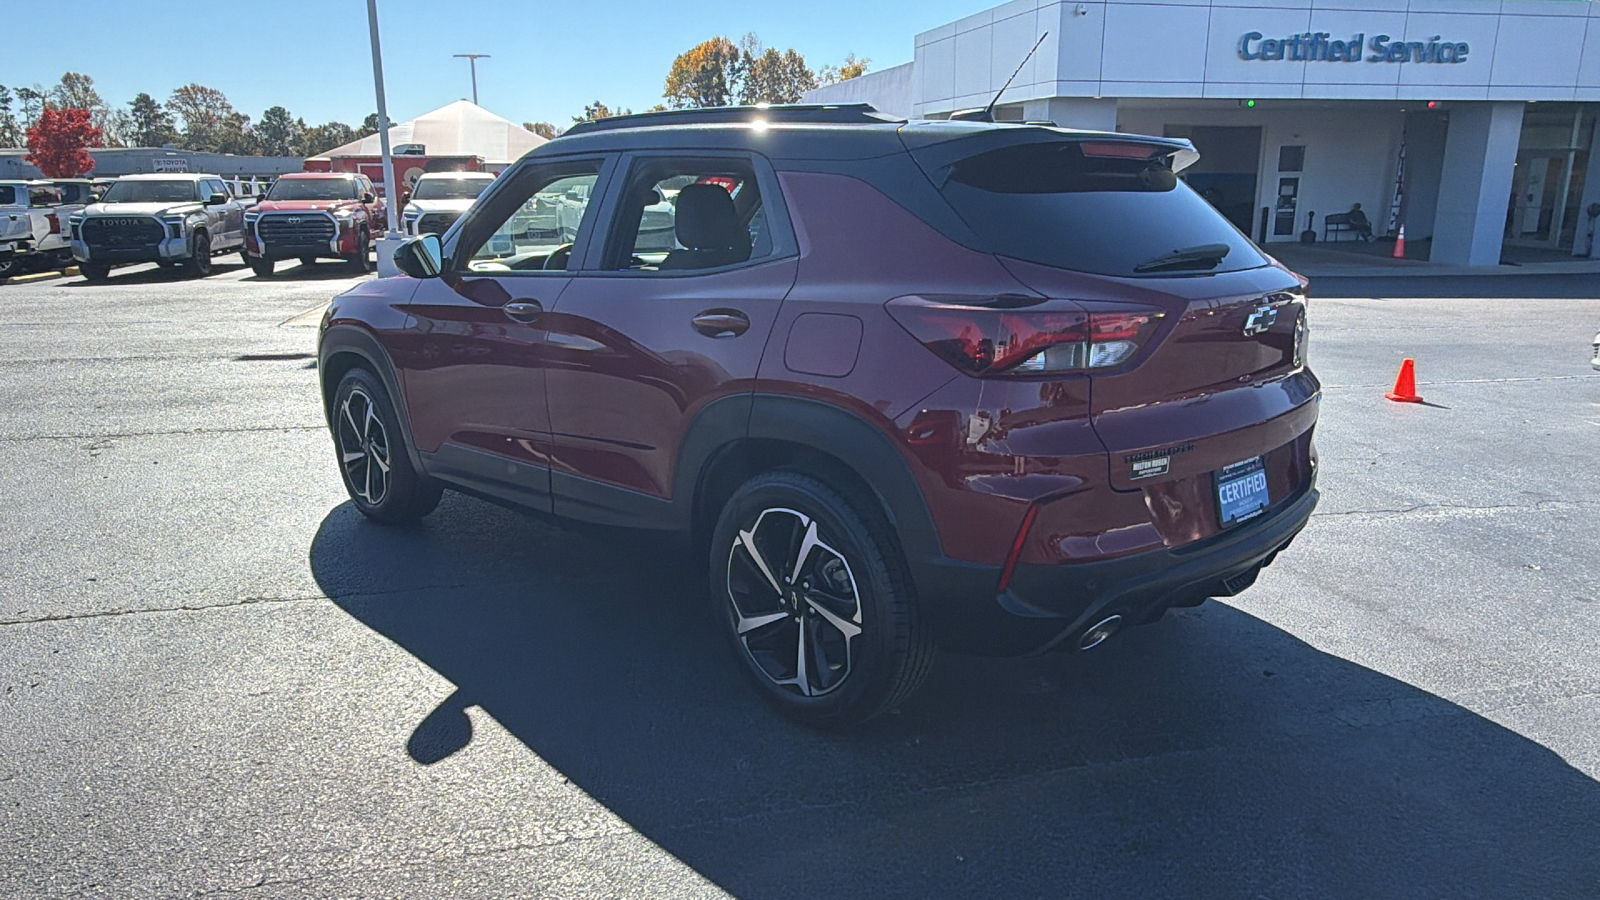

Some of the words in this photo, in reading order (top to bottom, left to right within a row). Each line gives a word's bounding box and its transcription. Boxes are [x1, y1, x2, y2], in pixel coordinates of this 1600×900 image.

[1238, 31, 1365, 61] Certified
[1367, 35, 1470, 63] Service
[1219, 472, 1267, 505] CERTIFIED
